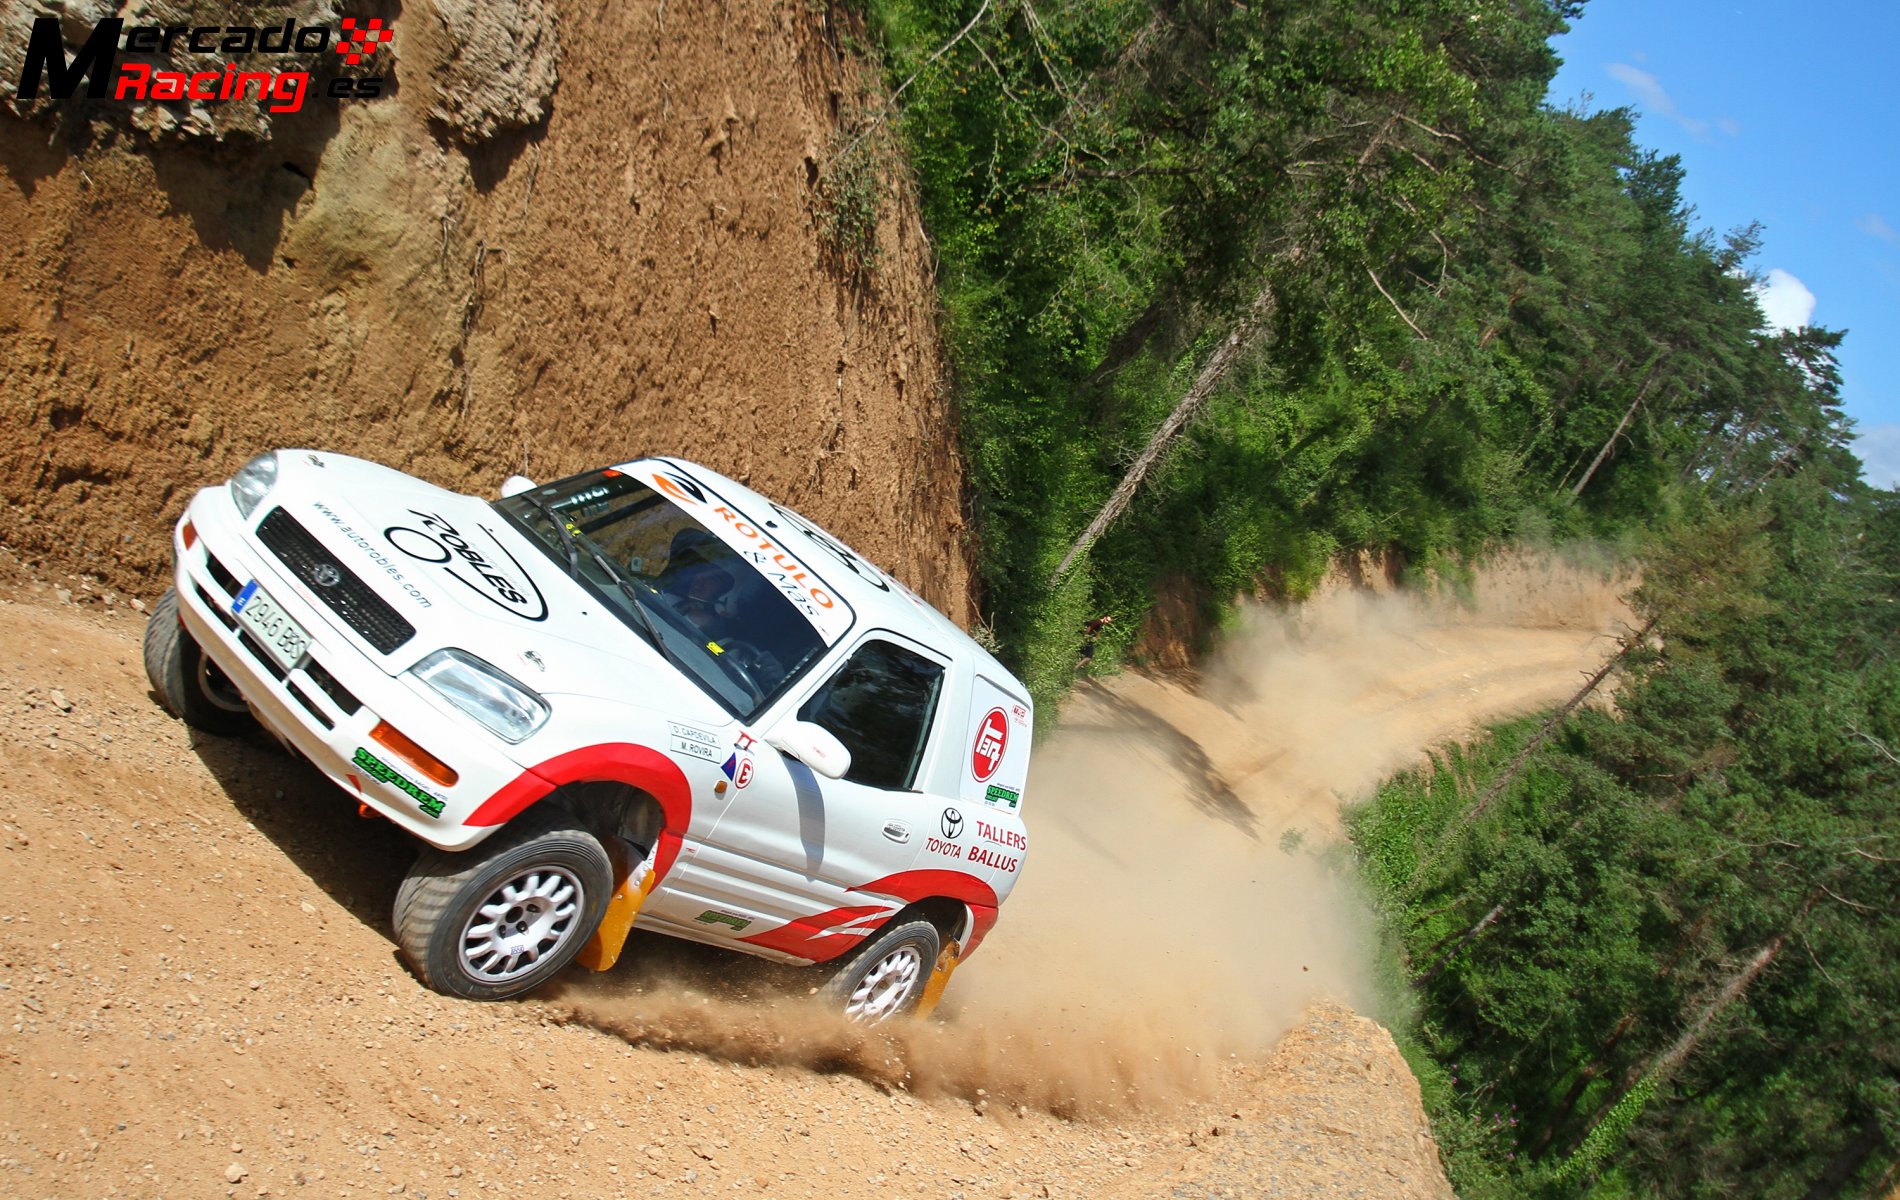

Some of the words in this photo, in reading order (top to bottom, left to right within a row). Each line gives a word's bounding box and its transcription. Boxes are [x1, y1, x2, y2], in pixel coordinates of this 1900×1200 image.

[313, 501, 432, 608] www.autorobles.com
[713, 507, 834, 609] ROTULO
[744, 550, 766, 564] &
[245, 595, 283, 637] 2946
[690, 743, 713, 758] ROVIRA
[355, 747, 446, 814] SPEEDREM
[738, 763, 751, 784] E
[925, 837, 962, 859] TOYOTA
[976, 820, 1027, 851] TALLERS
[967, 846, 1018, 873] BALLUS
